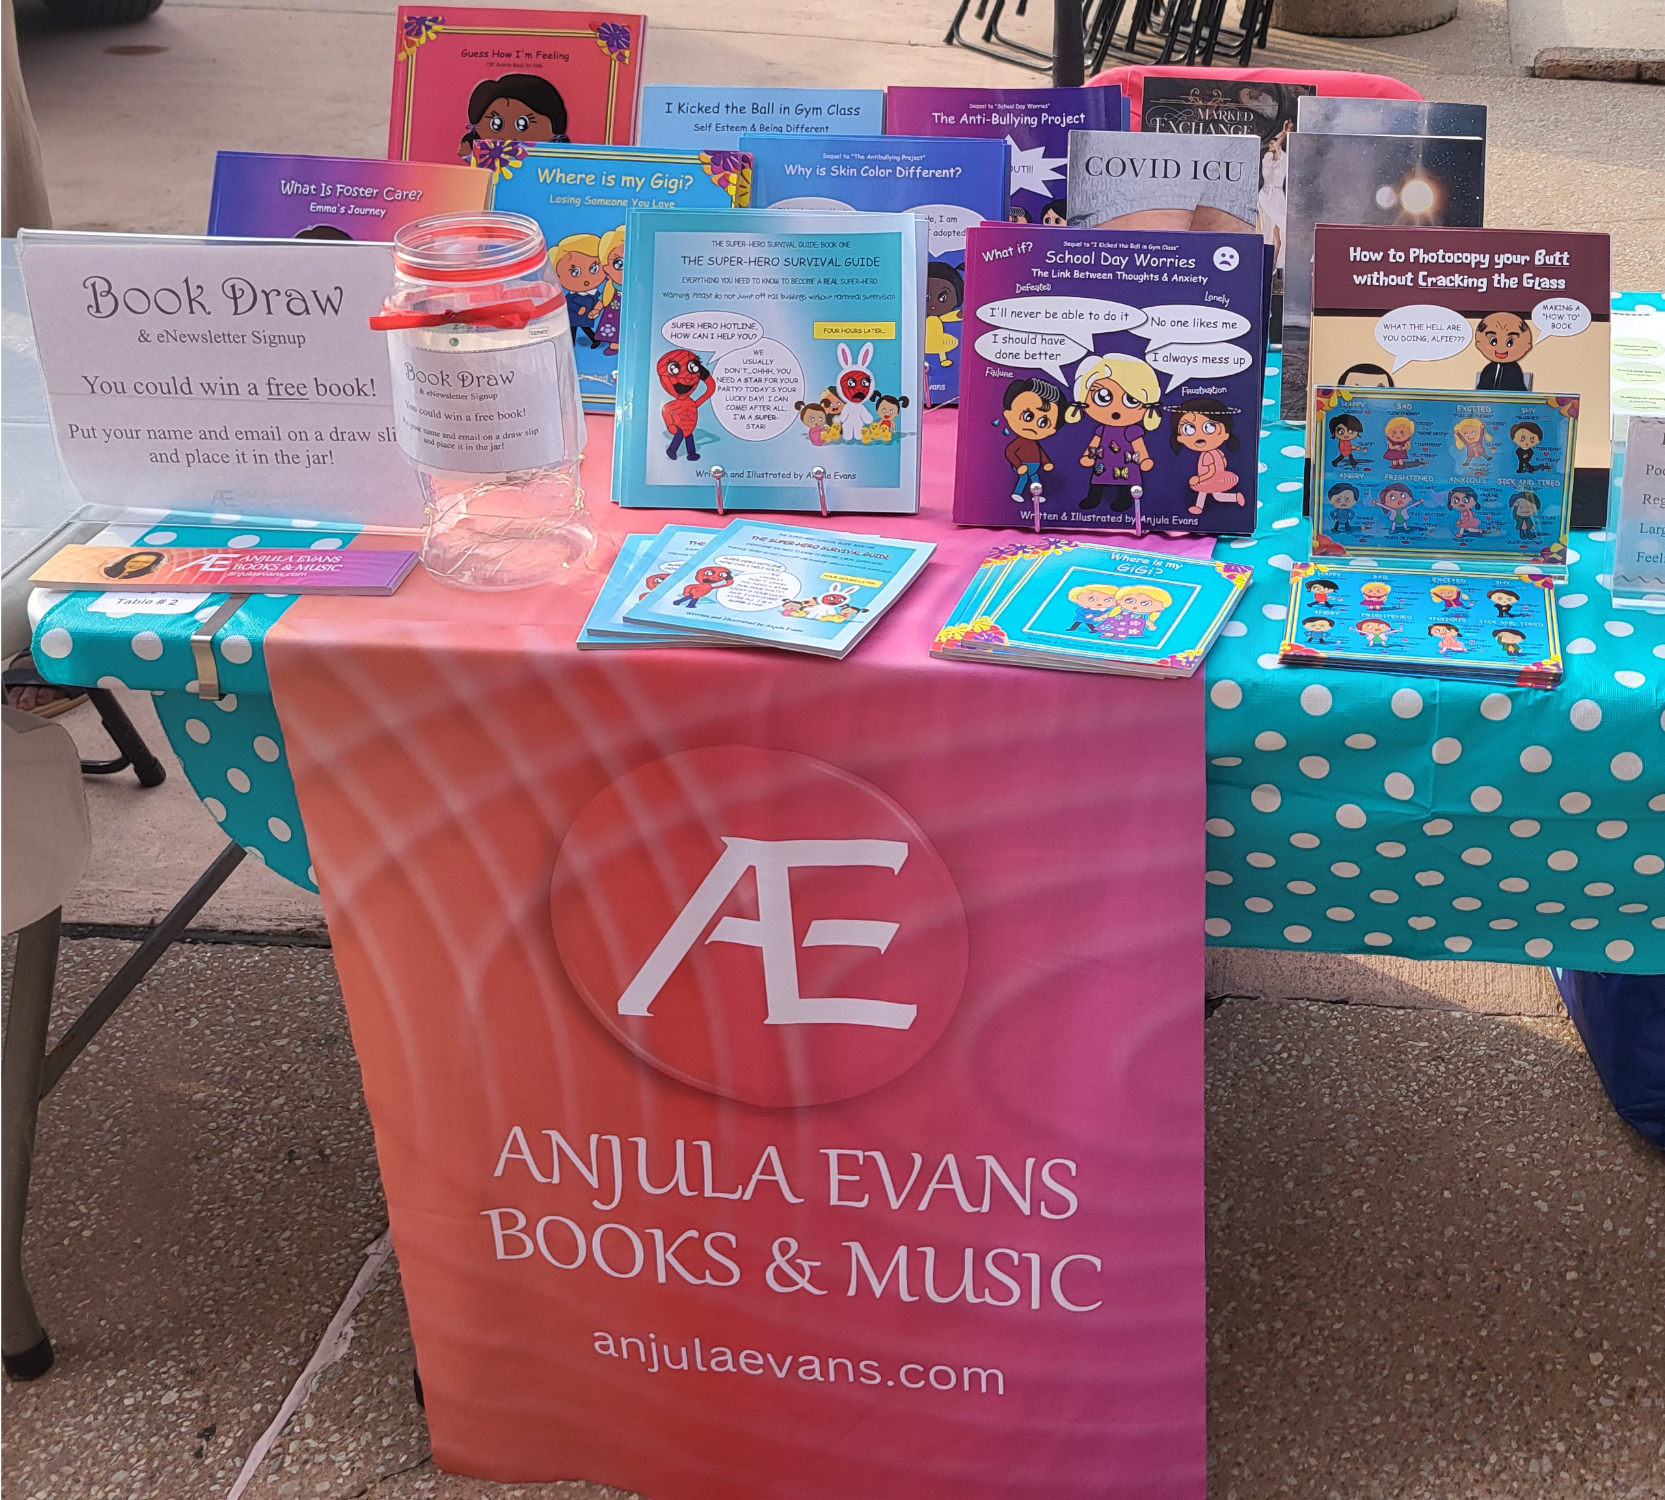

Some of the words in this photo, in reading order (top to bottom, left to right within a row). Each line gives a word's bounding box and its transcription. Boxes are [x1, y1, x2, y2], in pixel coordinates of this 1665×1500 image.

[461, 49, 489, 58] Guess
[492, 50, 512, 58] How
[515, 50, 532, 59] I'm
[536, 51, 569, 62] Feeling
[665, 103, 672, 114] I
[678, 103, 720, 114] Kicked
[725, 103, 746, 114] the
[752, 103, 774, 114] Ball
[780, 103, 790, 114] in
[795, 104, 822, 118] Gym
[827, 104, 860, 116] Class
[1197, 108, 1253, 122] MARKED
[694, 124, 712, 132] Self
[716, 124, 747, 132] Esteem
[759, 124, 782, 133] Being
[786, 124, 829, 133] Different
[932, 113, 956, 124] The
[960, 113, 1037, 128] Anti-Bullying
[1041, 114, 1085, 129] Project
[1155, 118, 1253, 135] EXCHANGE
[784, 164, 813, 178] Why
[816, 165, 826, 176] is
[830, 165, 857, 176] Skin
[861, 166, 892, 177] Color
[896, 167, 961, 178] Different?
[1085, 156, 1181, 179] COVID
[1191, 160, 1244, 181] ICU
[537, 168, 595, 185] Where
[602, 171, 615, 185] is
[621, 178, 645, 191] my
[651, 174, 693, 194] Gigi?
[281, 180, 317, 195] What
[320, 183, 332, 196] Is
[336, 184, 379, 198] Foster
[383, 187, 422, 201] Care?
[550, 194, 581, 207] Losing
[585, 196, 628, 206] Someone
[631, 198, 649, 207] You
[652, 199, 674, 208] Love
[310, 203, 345, 213] Emma's
[348, 205, 386, 218] Journey
[982, 250, 1014, 262] What
[1017, 243, 1033, 256] if?
[1046, 251, 1095, 264] School
[1100, 252, 1128, 269] Day
[1134, 253, 1195, 268] Worries
[1350, 247, 1383, 262] How
[1388, 248, 1405, 262] to
[1410, 249, 1489, 268] Photocopy
[1494, 252, 1530, 268] your
[1535, 251, 1570, 266] Butt
[682, 256, 703, 266] THE
[707, 256, 780, 267] SUPER-HERO
[784, 257, 841, 267] SURVIVAL
[844, 257, 880, 267] GUIDE
[1032, 269, 1049, 278] The
[1052, 270, 1071, 279] Link
[1074, 270, 1113, 280] Between
[1116, 272, 1159, 283] Thoughts
[1162, 273, 1168, 281] &
[1172, 274, 1208, 285] Anxiety
[1354, 272, 1414, 286] without
[1418, 273, 1487, 292] Cracking
[1492, 273, 1518, 289] the
[82, 276, 211, 318] Book
[222, 277, 343, 316] Draw
[990, 308, 1007, 318] I'll
[1010, 310, 1041, 319] never
[1045, 309, 1058, 320] be
[1062, 310, 1085, 320] able
[1089, 311, 1100, 321] to
[1104, 312, 1116, 321] do
[1121, 312, 1129, 322] it
[698, 322, 718, 330] HERO
[720, 322, 759, 331] HOTLINE,
[1151, 317, 1167, 327] No
[1170, 319, 1189, 328] one
[1193, 318, 1218, 329] likes
[1222, 320, 1237, 330] me
[138, 330, 152, 342] &
[157, 330, 247, 344] eNewsletter
[252, 331, 306, 348] Signup
[992, 334, 999, 344] I
[1001, 334, 1037, 345] should
[1041, 336, 1066, 346] have
[995, 350, 1020, 360] done
[1024, 350, 1061, 361] better
[1153, 352, 1159, 362] I
[1162, 353, 1198, 364] always
[1202, 356, 1230, 364] mess
[1233, 357, 1246, 368] up
[405, 362, 452, 387] Book
[457, 371, 515, 388] Draw
[82, 375, 126, 395] You
[133, 376, 193, 395] could
[199, 377, 240, 396] win
[248, 383, 260, 396] a
[267, 378, 308, 398] free
[316, 378, 377, 397] book!
[1457, 405, 1491, 413] EXCITED
[68, 424, 97, 439] Put
[102, 427, 141, 444] your
[147, 428, 193, 441] name
[199, 425, 229, 441] and
[235, 426, 282, 442] email
[288, 431, 309, 442] on
[315, 431, 324, 442] a
[329, 427, 371, 442] draw
[377, 427, 397, 442] sli
[150, 450, 180, 464] and
[185, 451, 230, 468] place
[236, 451, 248, 464] it
[252, 451, 269, 464] in
[273, 451, 300, 465] the
[304, 451, 334, 468] jar!
[1384, 474, 1433, 482] FRIGHTENED
[240, 554, 294, 563] ANJULA
[296, 554, 343, 563] EVANS
[1109, 553, 1150, 566] Where
[1154, 558, 1162, 566] is
[1166, 561, 1182, 570] my
[232, 563, 278, 571] BOOKS
[294, 564, 344, 572] MUSIC
[117, 598, 152, 606] Table
[156, 598, 165, 606] #
[170, 598, 179, 606] 2
[494, 1126, 804, 1210] ANJULA
[820, 1149, 1078, 1220] EVANS
[481, 1208, 741, 1287] BOOKS
[766, 1237, 827, 1295] &
[842, 1240, 1102, 1312] MUSIC
[594, 1331, 1005, 1396] anjulaevans.com
